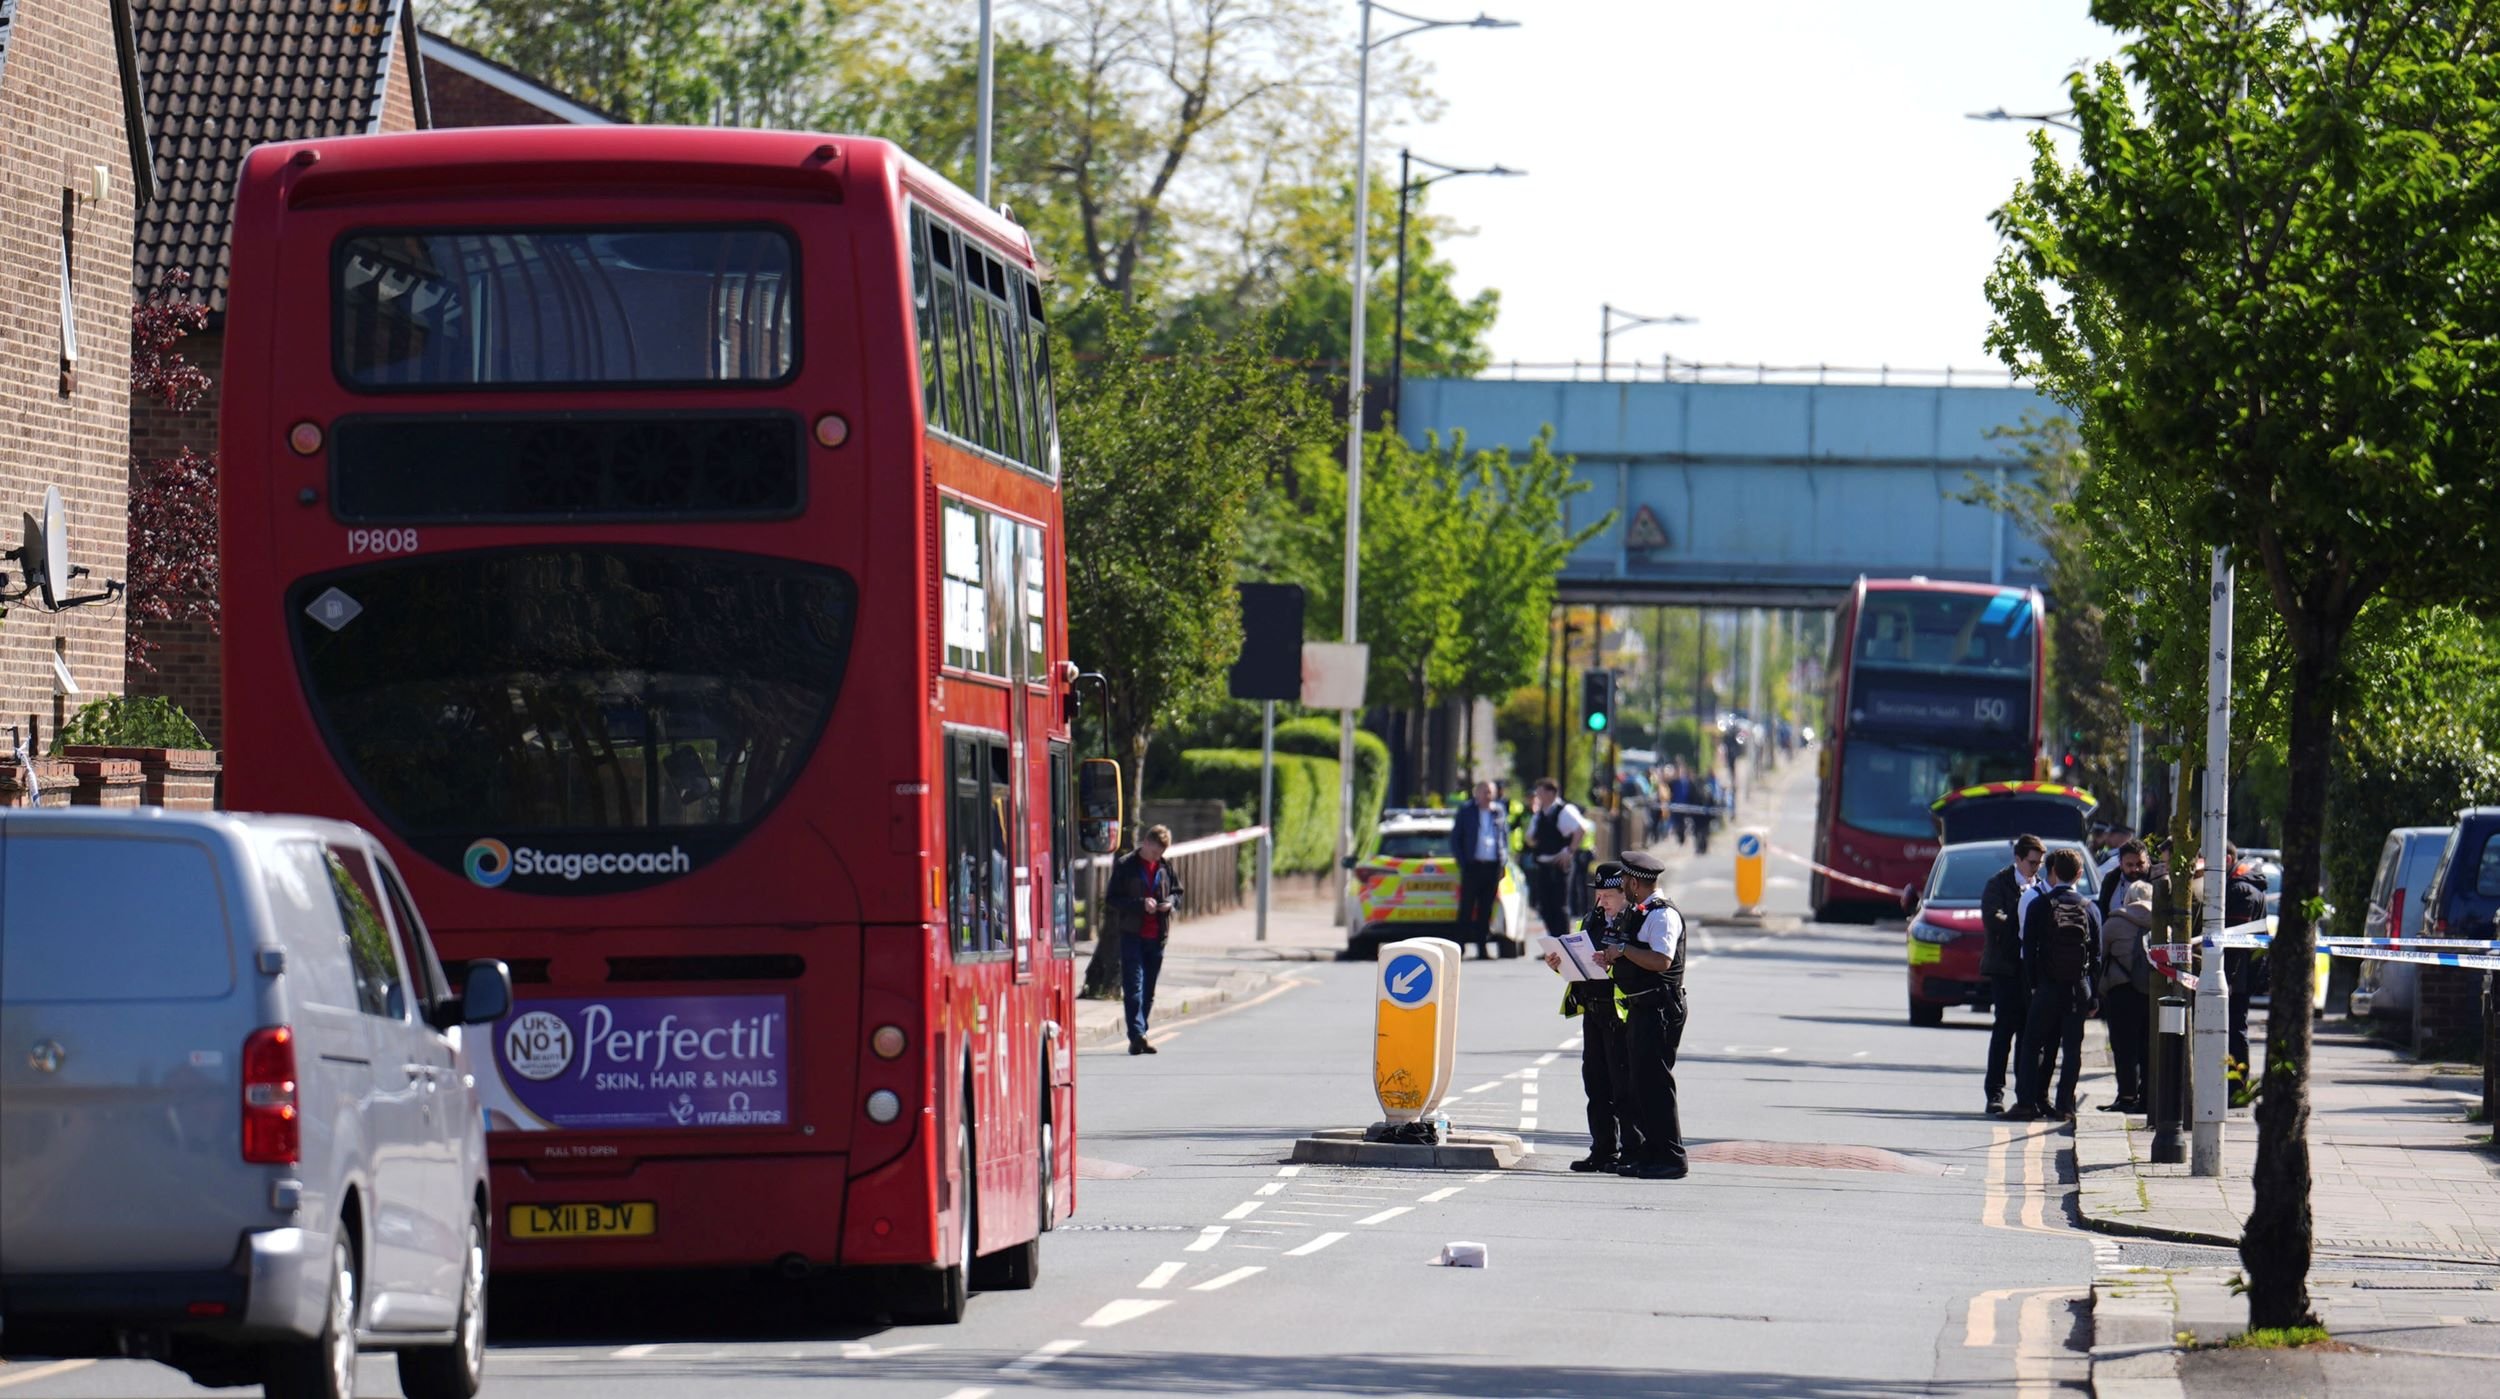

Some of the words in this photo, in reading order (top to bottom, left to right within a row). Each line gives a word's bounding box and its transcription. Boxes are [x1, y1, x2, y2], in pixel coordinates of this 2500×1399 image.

[347, 528, 418, 554] 19808
[1973, 697, 2006, 721] 150
[514, 845, 690, 881] Stagecoach
[580, 1004, 775, 1080] Perfectil
[595, 1072, 644, 1090] SKIN,
[650, 1071, 697, 1088] HAIR
[703, 1071, 717, 1087] &
[722, 1069, 778, 1087] NAILS
[697, 1109, 782, 1125] VITABIOTICS
[545, 1146, 569, 1158] PULL
[572, 1145, 587, 1157] TO
[589, 1144, 618, 1157] OPEN
[530, 1207, 577, 1232] LX11
[585, 1205, 633, 1230] BJV
